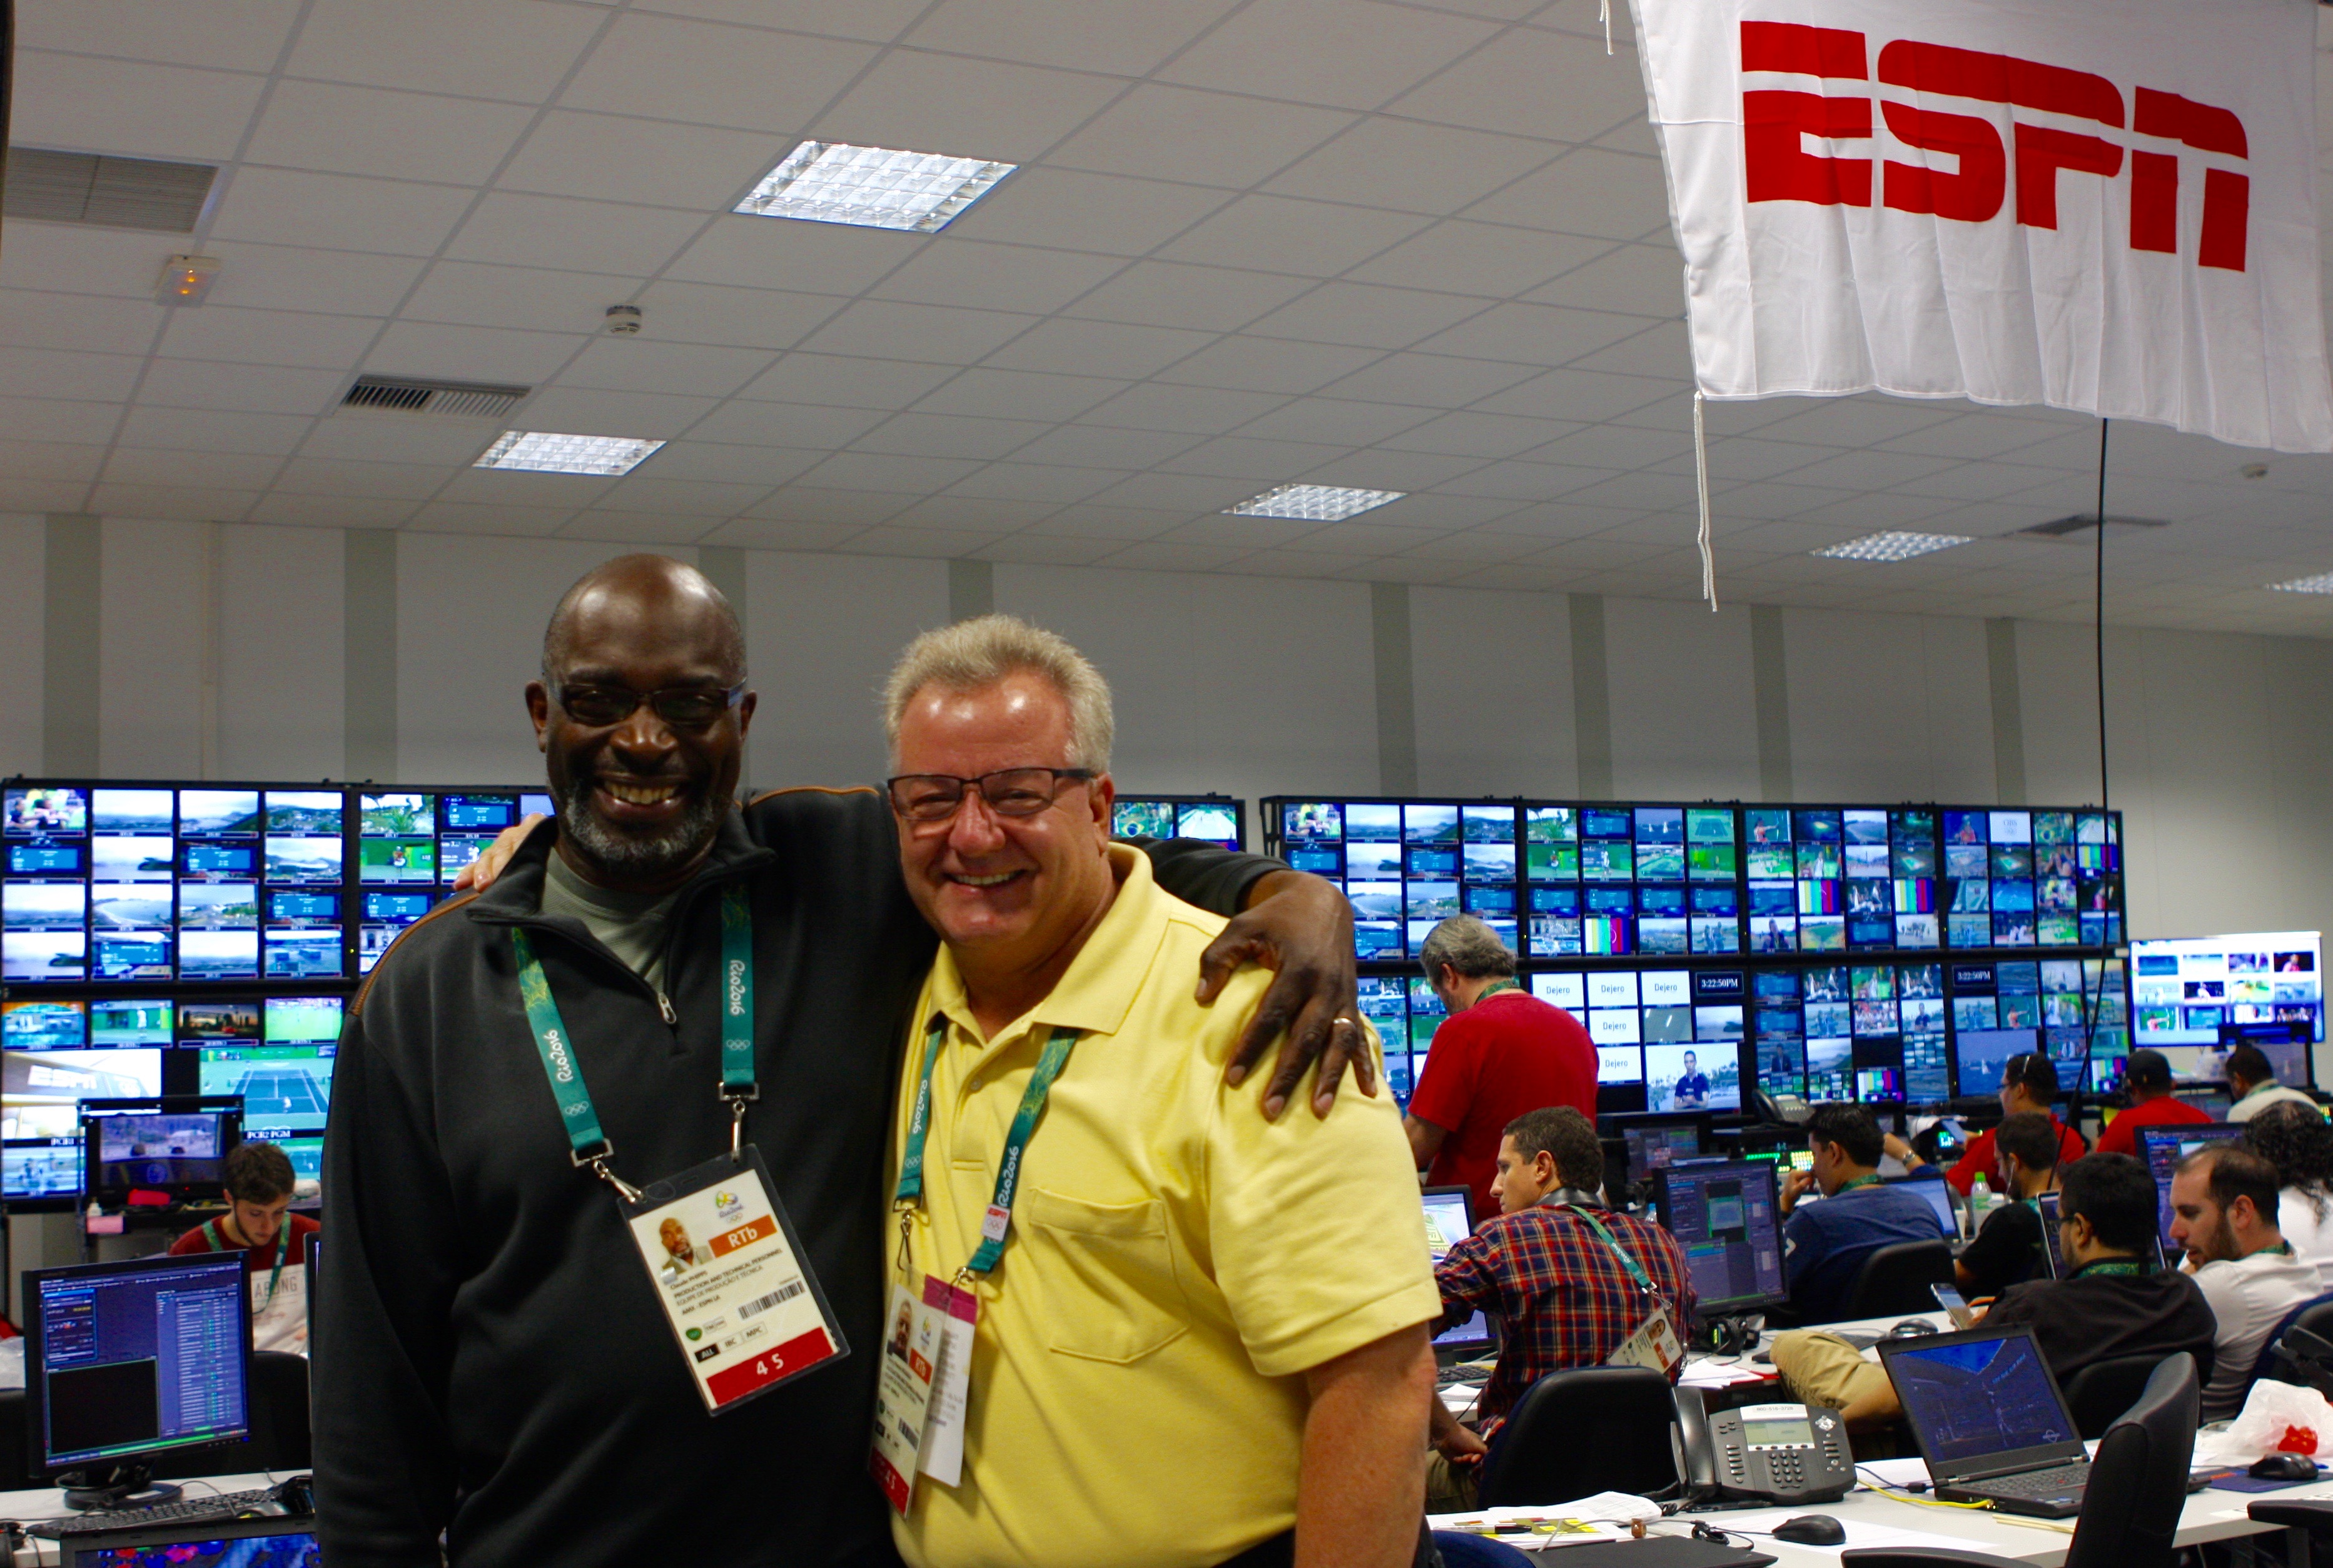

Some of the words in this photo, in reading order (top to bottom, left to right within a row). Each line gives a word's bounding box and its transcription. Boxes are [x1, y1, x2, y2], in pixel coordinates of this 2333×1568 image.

[1741, 21, 2250, 272] ESPN
[729, 959, 746, 1016] Rio2016
[1546, 986, 1571, 996] Dejero
[1601, 984, 1625, 995] Dejero
[1654, 983, 1678, 994] Dejero
[1701, 978, 1738, 988] 3:22:50PM
[1602, 1021, 1627, 1032] Dejero
[543, 1029, 574, 1083] Rio2016
[1605, 1059, 1628, 1069] Dejero
[28, 1065, 98, 1090] ESPN
[912, 1079, 929, 1135] Rio2016
[997, 1145, 1020, 1207] Rio2016
[727, 1227, 758, 1248] RTb
[756, 1360, 769, 1375] 4
[771, 1353, 784, 1370] 5
